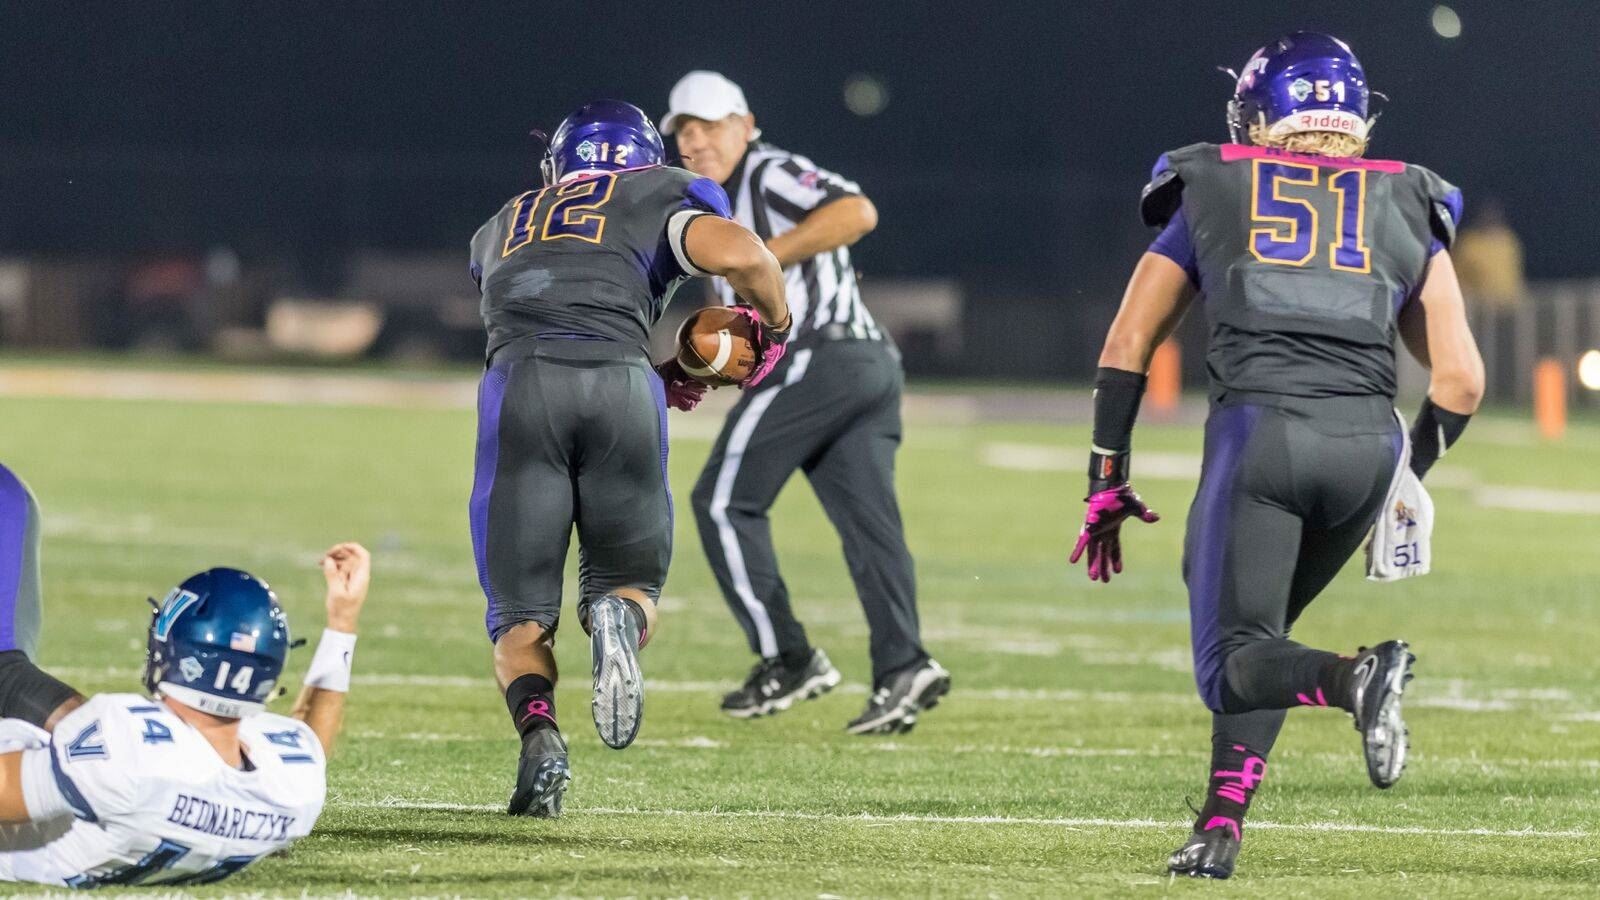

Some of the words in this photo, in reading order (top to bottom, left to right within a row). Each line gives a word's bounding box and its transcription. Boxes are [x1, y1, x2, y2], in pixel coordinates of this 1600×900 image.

[1315, 80, 1345, 103] 51
[601, 142, 628, 165] 12
[502, 172, 618, 258] 12
[1249, 159, 1371, 274] 51
[1393, 541, 1421, 567] 51
[213, 661, 254, 695] 14
[127, 706, 175, 744] 14
[167, 794, 296, 841] BEDNARCZYK
